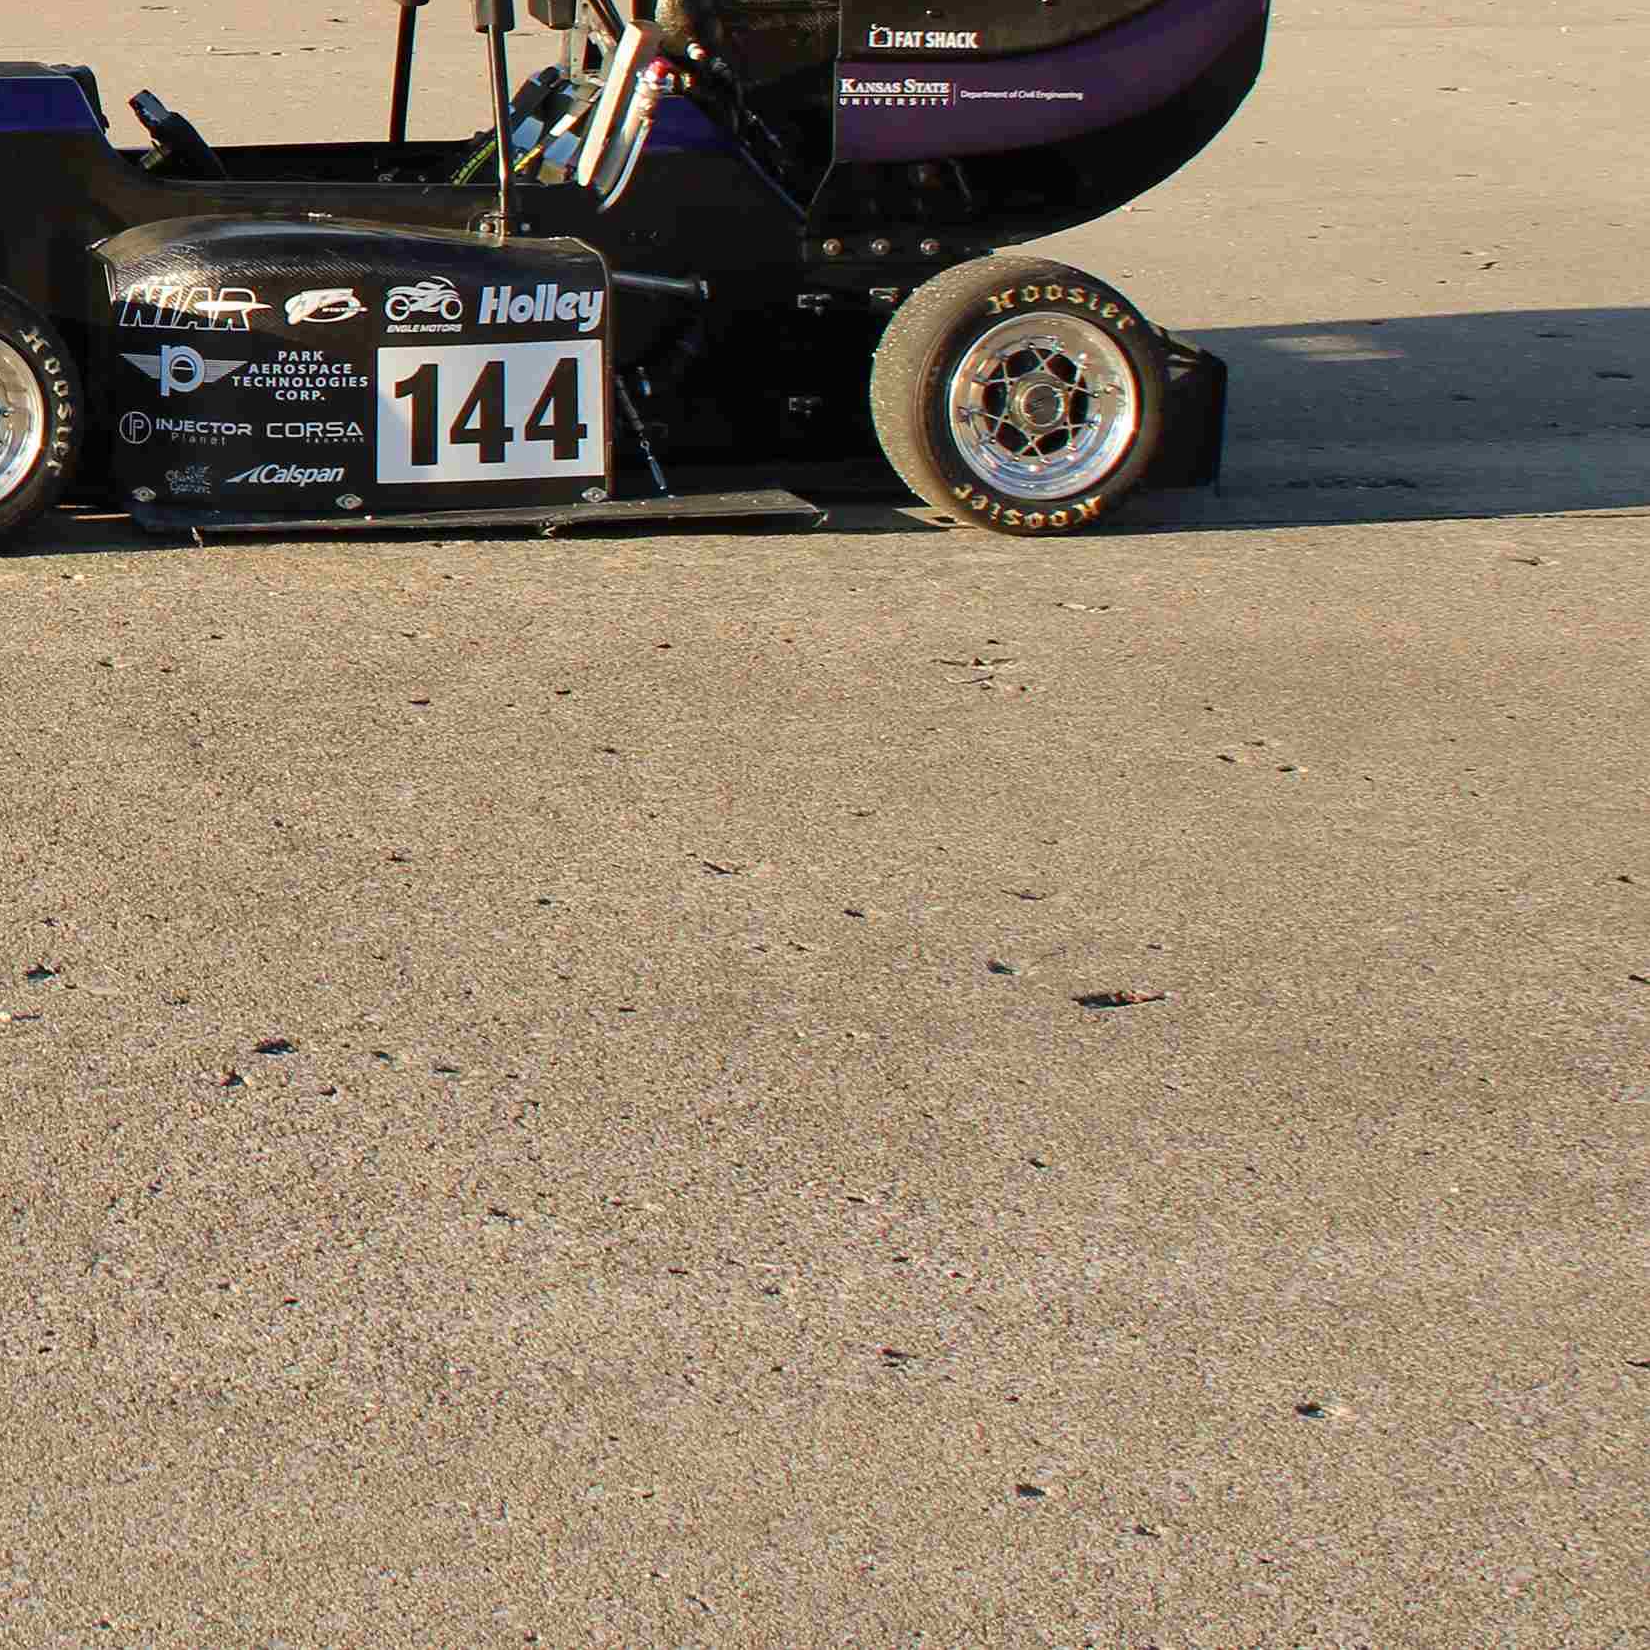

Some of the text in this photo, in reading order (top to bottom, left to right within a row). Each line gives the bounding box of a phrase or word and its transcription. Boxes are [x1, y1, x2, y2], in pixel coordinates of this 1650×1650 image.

[894, 30, 979, 49] FAT SHACK
[839, 97, 950, 106] UNIVERSITY
[478, 283, 605, 333] Holley
[986, 283, 1138, 332] Hoosier
[277, 350, 324, 362] PARK
[249, 363, 353, 375] AEROSPACE
[232, 375, 369, 388] TECHNOLOGIES
[274, 389, 326, 401] CORP.
[394, 357, 588, 466] 144
[155, 417, 253, 436] INJECTOR
[266, 421, 365, 438] CORSA
[171, 431, 227, 447] Planet
[259, 463, 345, 487] Calspan
